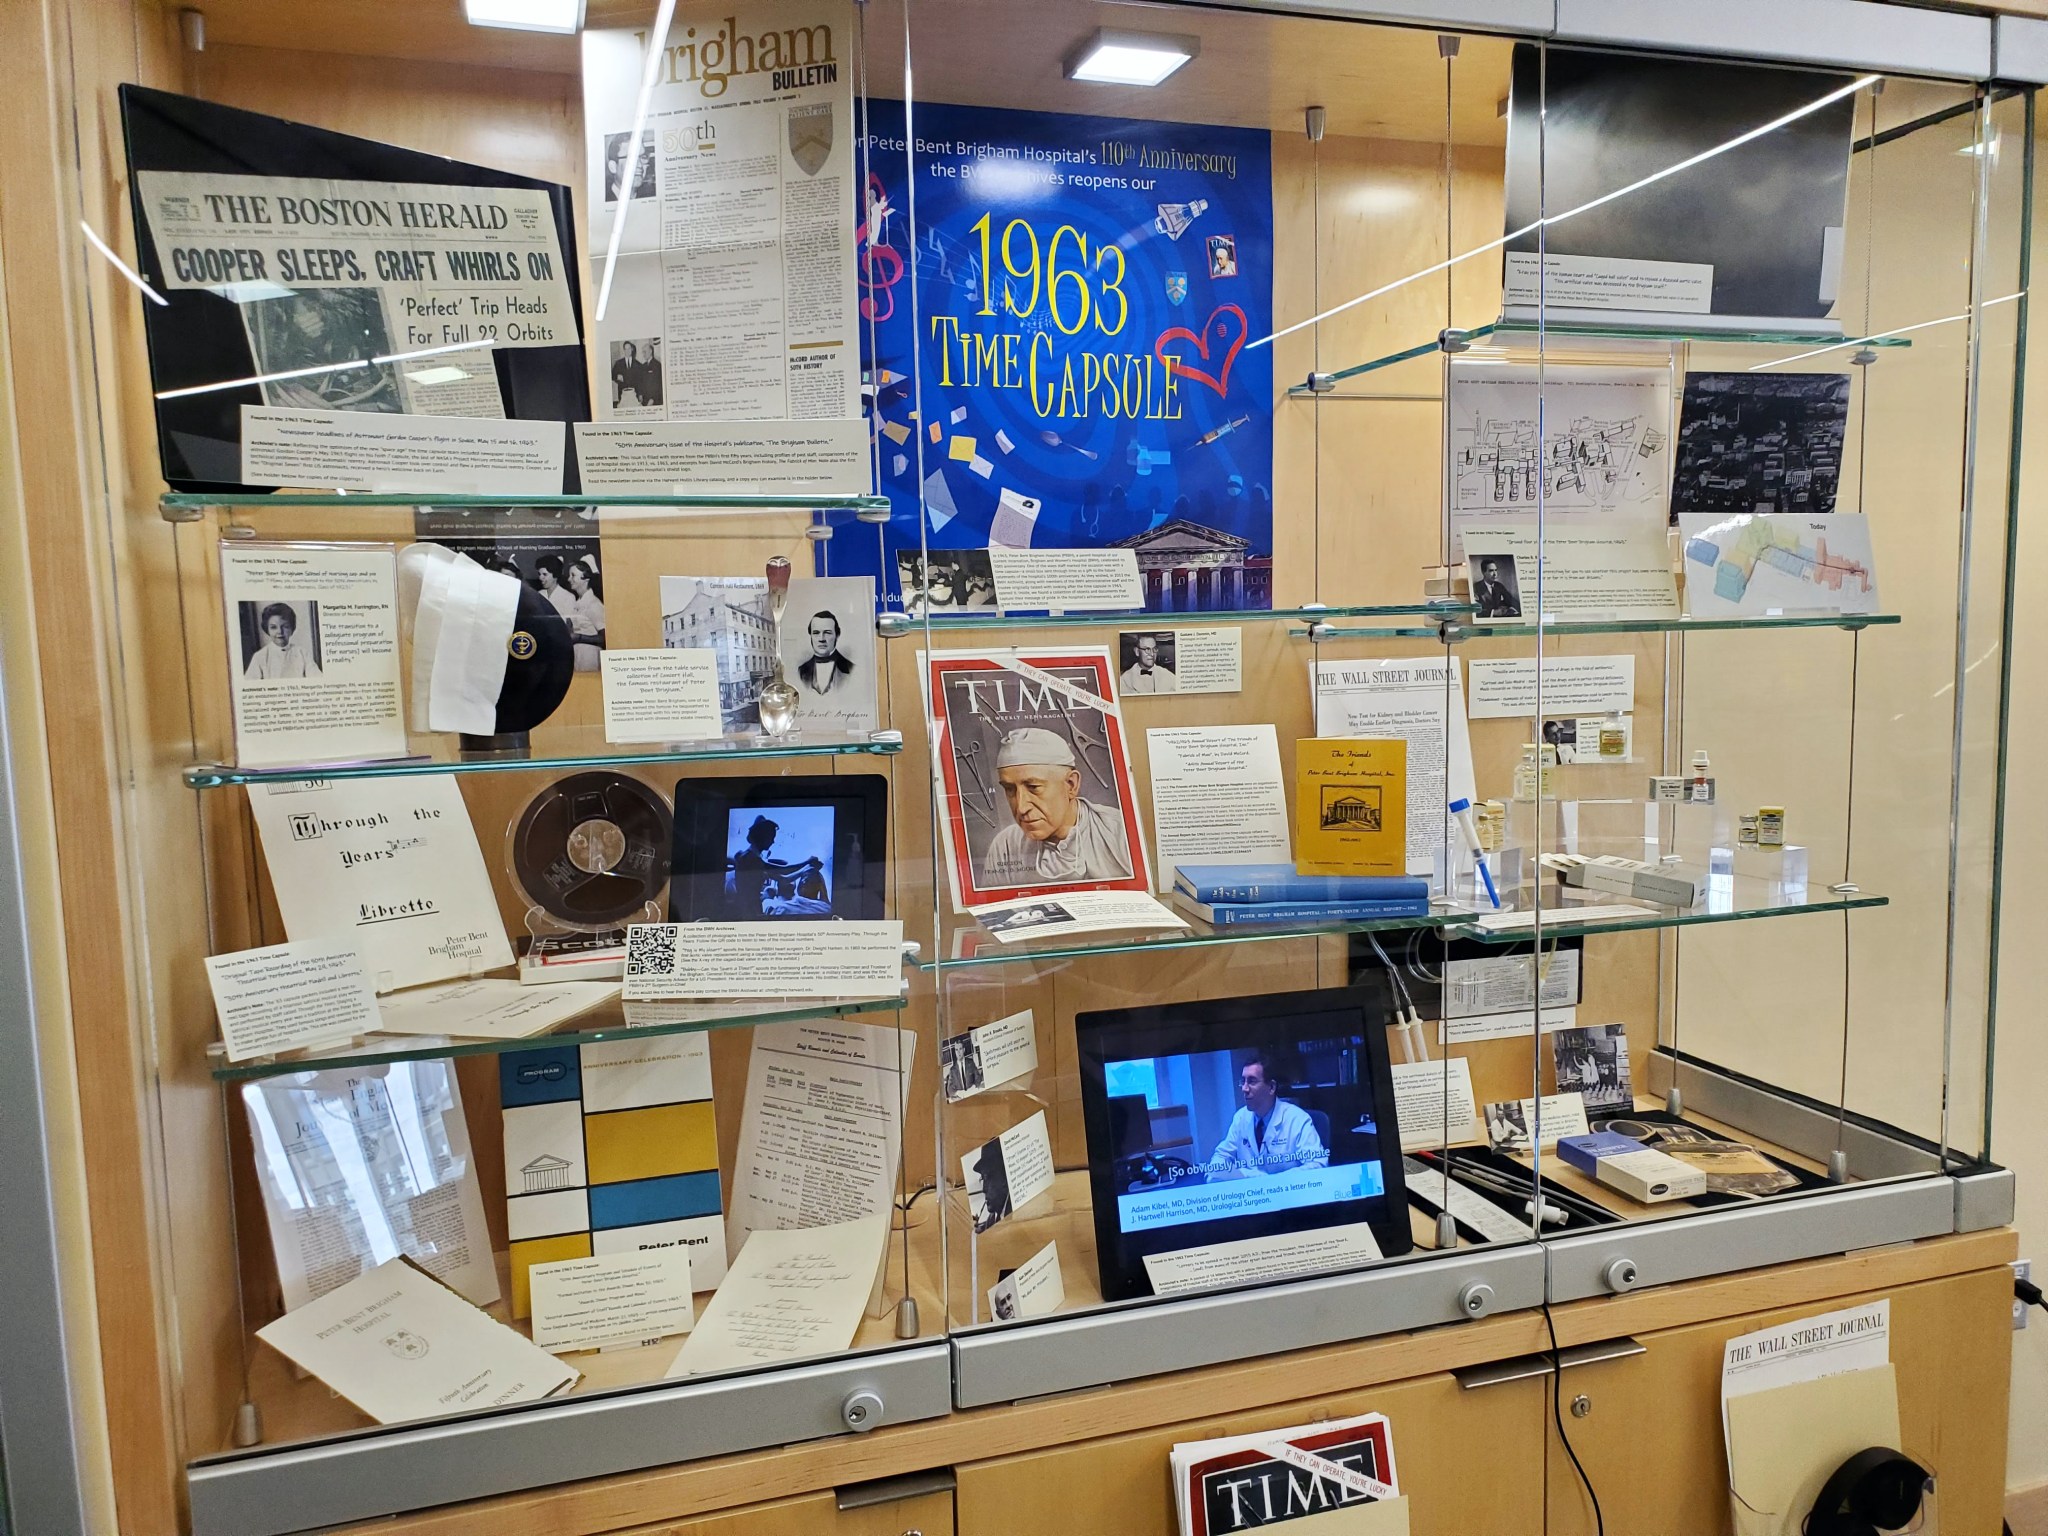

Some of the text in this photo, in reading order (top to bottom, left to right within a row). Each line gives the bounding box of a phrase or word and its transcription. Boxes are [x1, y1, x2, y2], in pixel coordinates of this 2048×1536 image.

[772, 63, 838, 91] BULLETIN
[664, 151, 717, 163] Anniversary News
[915, 138, 952, 155] Bent
[956, 141, 1020, 161] Brigham
[1024, 145, 1097, 166] Hospital's
[1101, 141, 1136, 166] 110th
[1139, 144, 1237, 180] Anniversary
[931, 162, 956, 178] the
[1068, 174, 1128, 191] reopens
[1131, 178, 1156, 191] our
[203, 194, 272, 224] THE
[276, 196, 393, 228] BOSTON
[397, 201, 508, 231] HERALD
[172, 247, 554, 282] COOPER SLEEPS, CRAFT WHIRLS ON
[969, 211, 1128, 337] 1963
[400, 295, 548, 318] 'Perfect' Trip Heads
[408, 322, 554, 344] For Full 22 Orbits
[804, 362, 823, 370] HISTORY
[1029, 331, 1182, 420] CAPSULE
[1809, 522, 1826, 532] Today
[1023, 666, 1037, 678] THEY
[1038, 673, 1049, 682] CAN
[1093, 698, 1111, 710] LUCKY
[1317, 668, 1457, 686] THE WALL STREET JOURNAL
[955, 676, 1092, 714] TIME
[1024, 712, 1076, 721] NEWSMAGAZINE
[1377, 711, 1393, 719] Kidney
[1331, 750, 1372, 758] The Friends
[292, 807, 441, 838] Through the
[339, 849, 395, 868] Years
[359, 898, 434, 921] Libretto
[1297, 910, 1321, 918] HOSPITAL
[428, 942, 465, 956] Brigham
[446, 931, 489, 946] Peter Bent
[448, 946, 482, 960] Hospital
[523, 1067, 560, 1077] PROGRAM
[583, 1059, 632, 1070] ANNIVERSARY
[634, 1053, 682, 1065] CELEBRATION
[1168, 1147, 1331, 1180] [So obviously he did not anticipate
[1131, 1204, 1151, 1214] Adam
[1151, 1201, 1170, 1212] Kibel,
[1171, 1199, 1185, 1209] MD,
[1186, 1195, 1212, 1206] Division
[1212, 1193, 1220, 1202] of
[1220, 1190, 1246, 1202] Urology
[1246, 1187, 1266, 1199] Chief,
[1266, 1184, 1284, 1195] reads
[1290, 1181, 1307, 1191] letter
[1307, 1180, 1323, 1189] from
[1131, 1214, 1137, 1224] J.
[1137, 1210, 1165, 1223] Hartwell
[1165, 1207, 1196, 1220] Harrison,
[1196, 1203, 1210, 1214] MD,
[1211, 1199, 1243, 1213] Urological
[638, 1235, 709, 1251] Peter Bent
[316, 1290, 403, 1340] PETER BENT BRIGHAM
[352, 1311, 392, 1335] HOSPITAL
[1730, 1312, 1884, 1364] THE WALL STREET JOURNAL
[493, 1381, 525, 1406] DINNER
[1285, 1448, 1293, 1457] IF
[1293, 1450, 1308, 1462] THEY
[1309, 1458, 1321, 1469] CAN
[1349, 1474, 1369, 1489] YOU'RE
[1369, 1483, 1388, 1496] LUCKY
[1216, 1453, 1368, 1528] TIME
